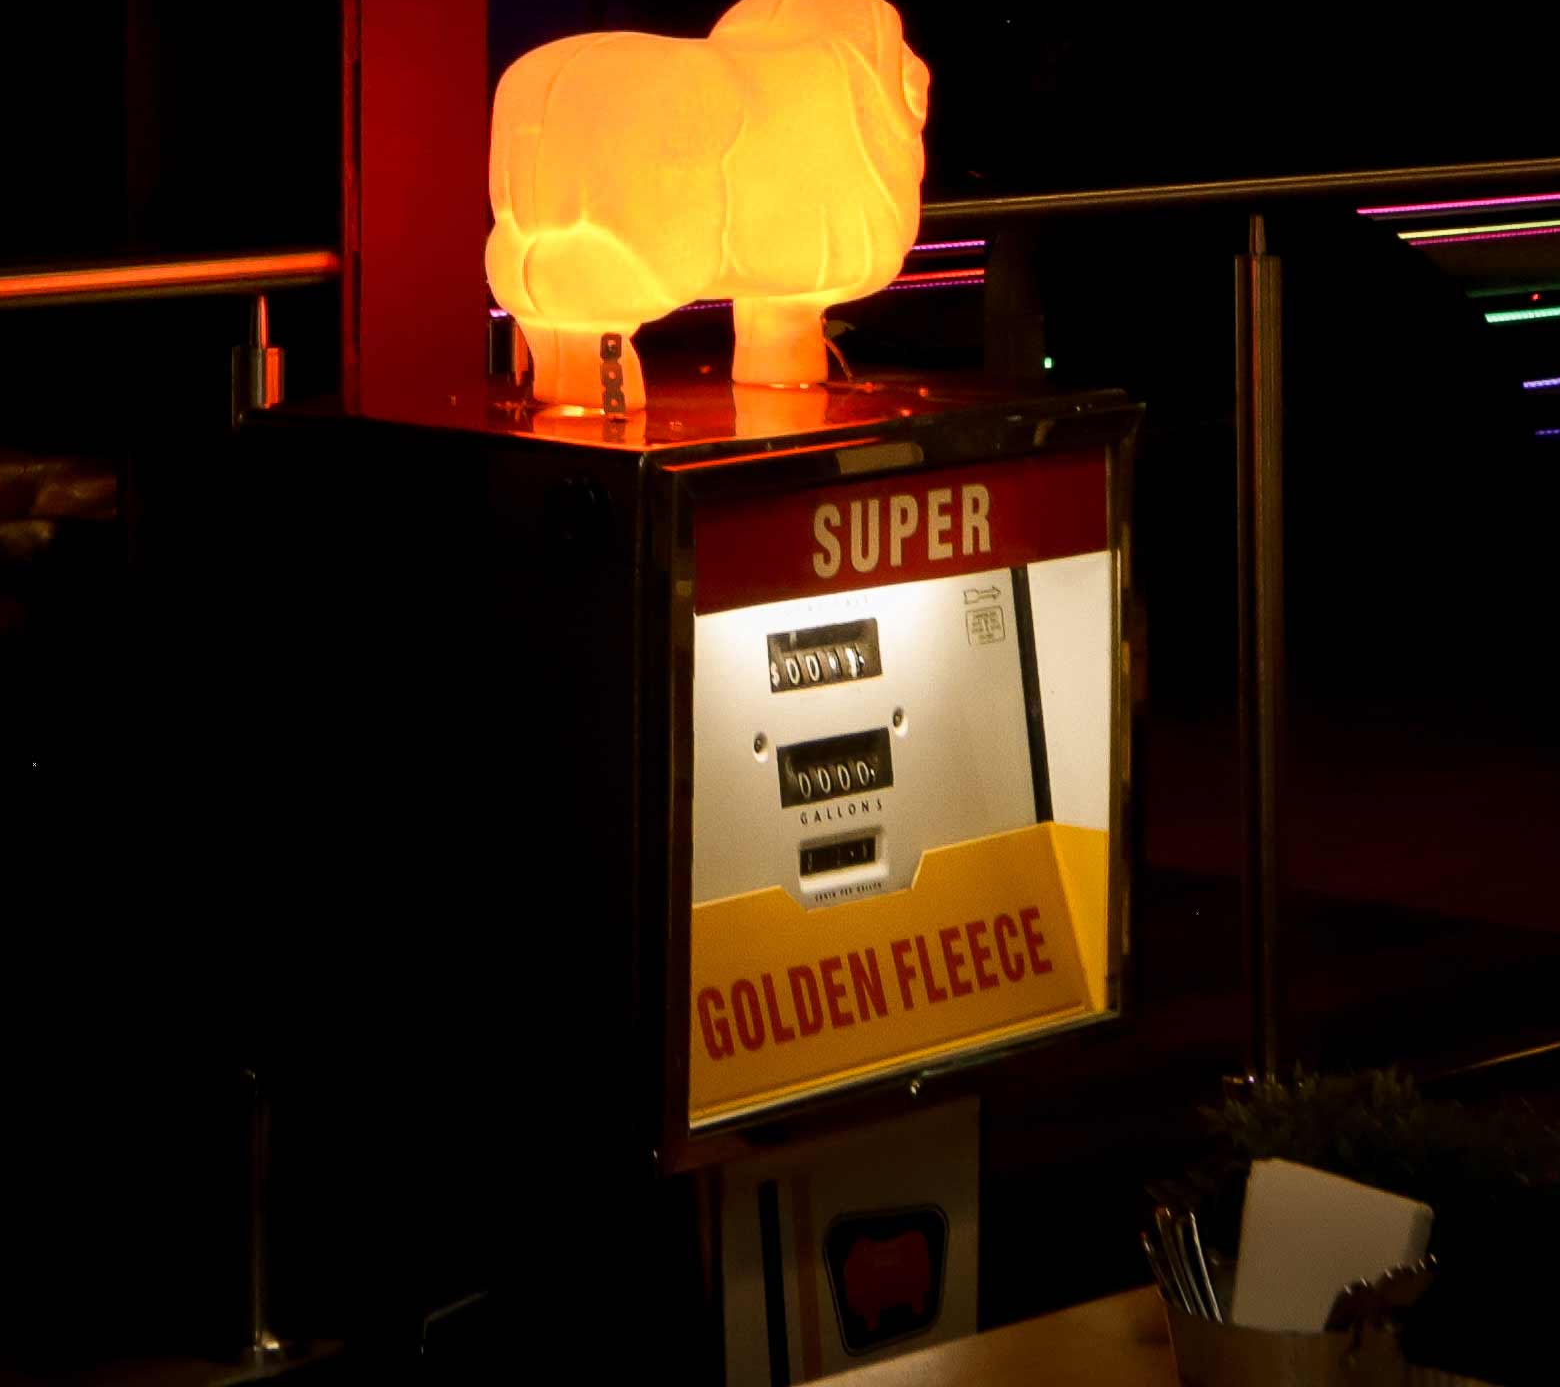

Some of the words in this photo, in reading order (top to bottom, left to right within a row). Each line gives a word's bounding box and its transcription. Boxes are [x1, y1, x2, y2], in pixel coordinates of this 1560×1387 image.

[812, 483, 992, 579] SUPER
[800, 798, 882, 826] GALLONS
[697, 946, 888, 1061] GOLDEN
[892, 906, 1053, 1011] FLEECE
